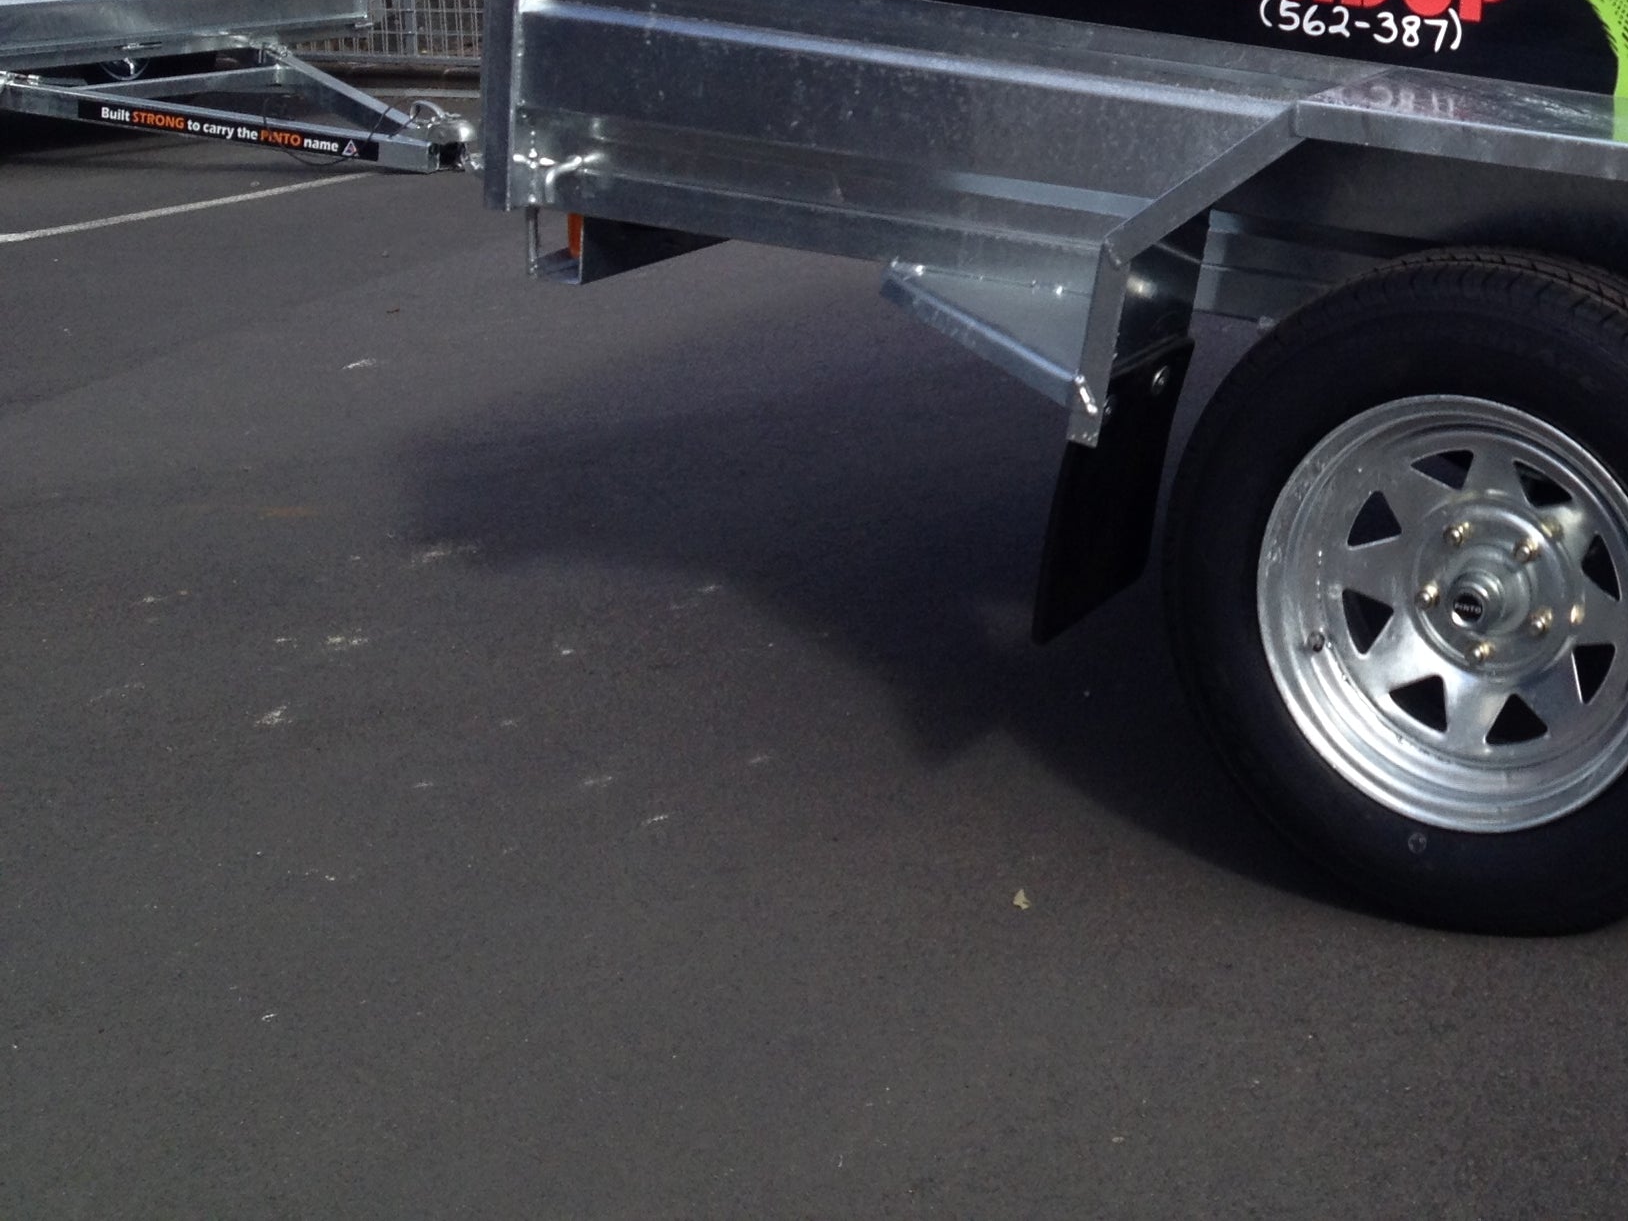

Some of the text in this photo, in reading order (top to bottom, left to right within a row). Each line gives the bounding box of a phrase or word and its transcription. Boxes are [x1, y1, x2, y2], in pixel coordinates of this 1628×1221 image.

[101, 107, 130, 122] Built
[132, 111, 185, 129] STRONG
[187, 119, 201, 131] to
[203, 123, 234, 139] carry
[237, 127, 258, 140] the
[303, 138, 339, 152] name
